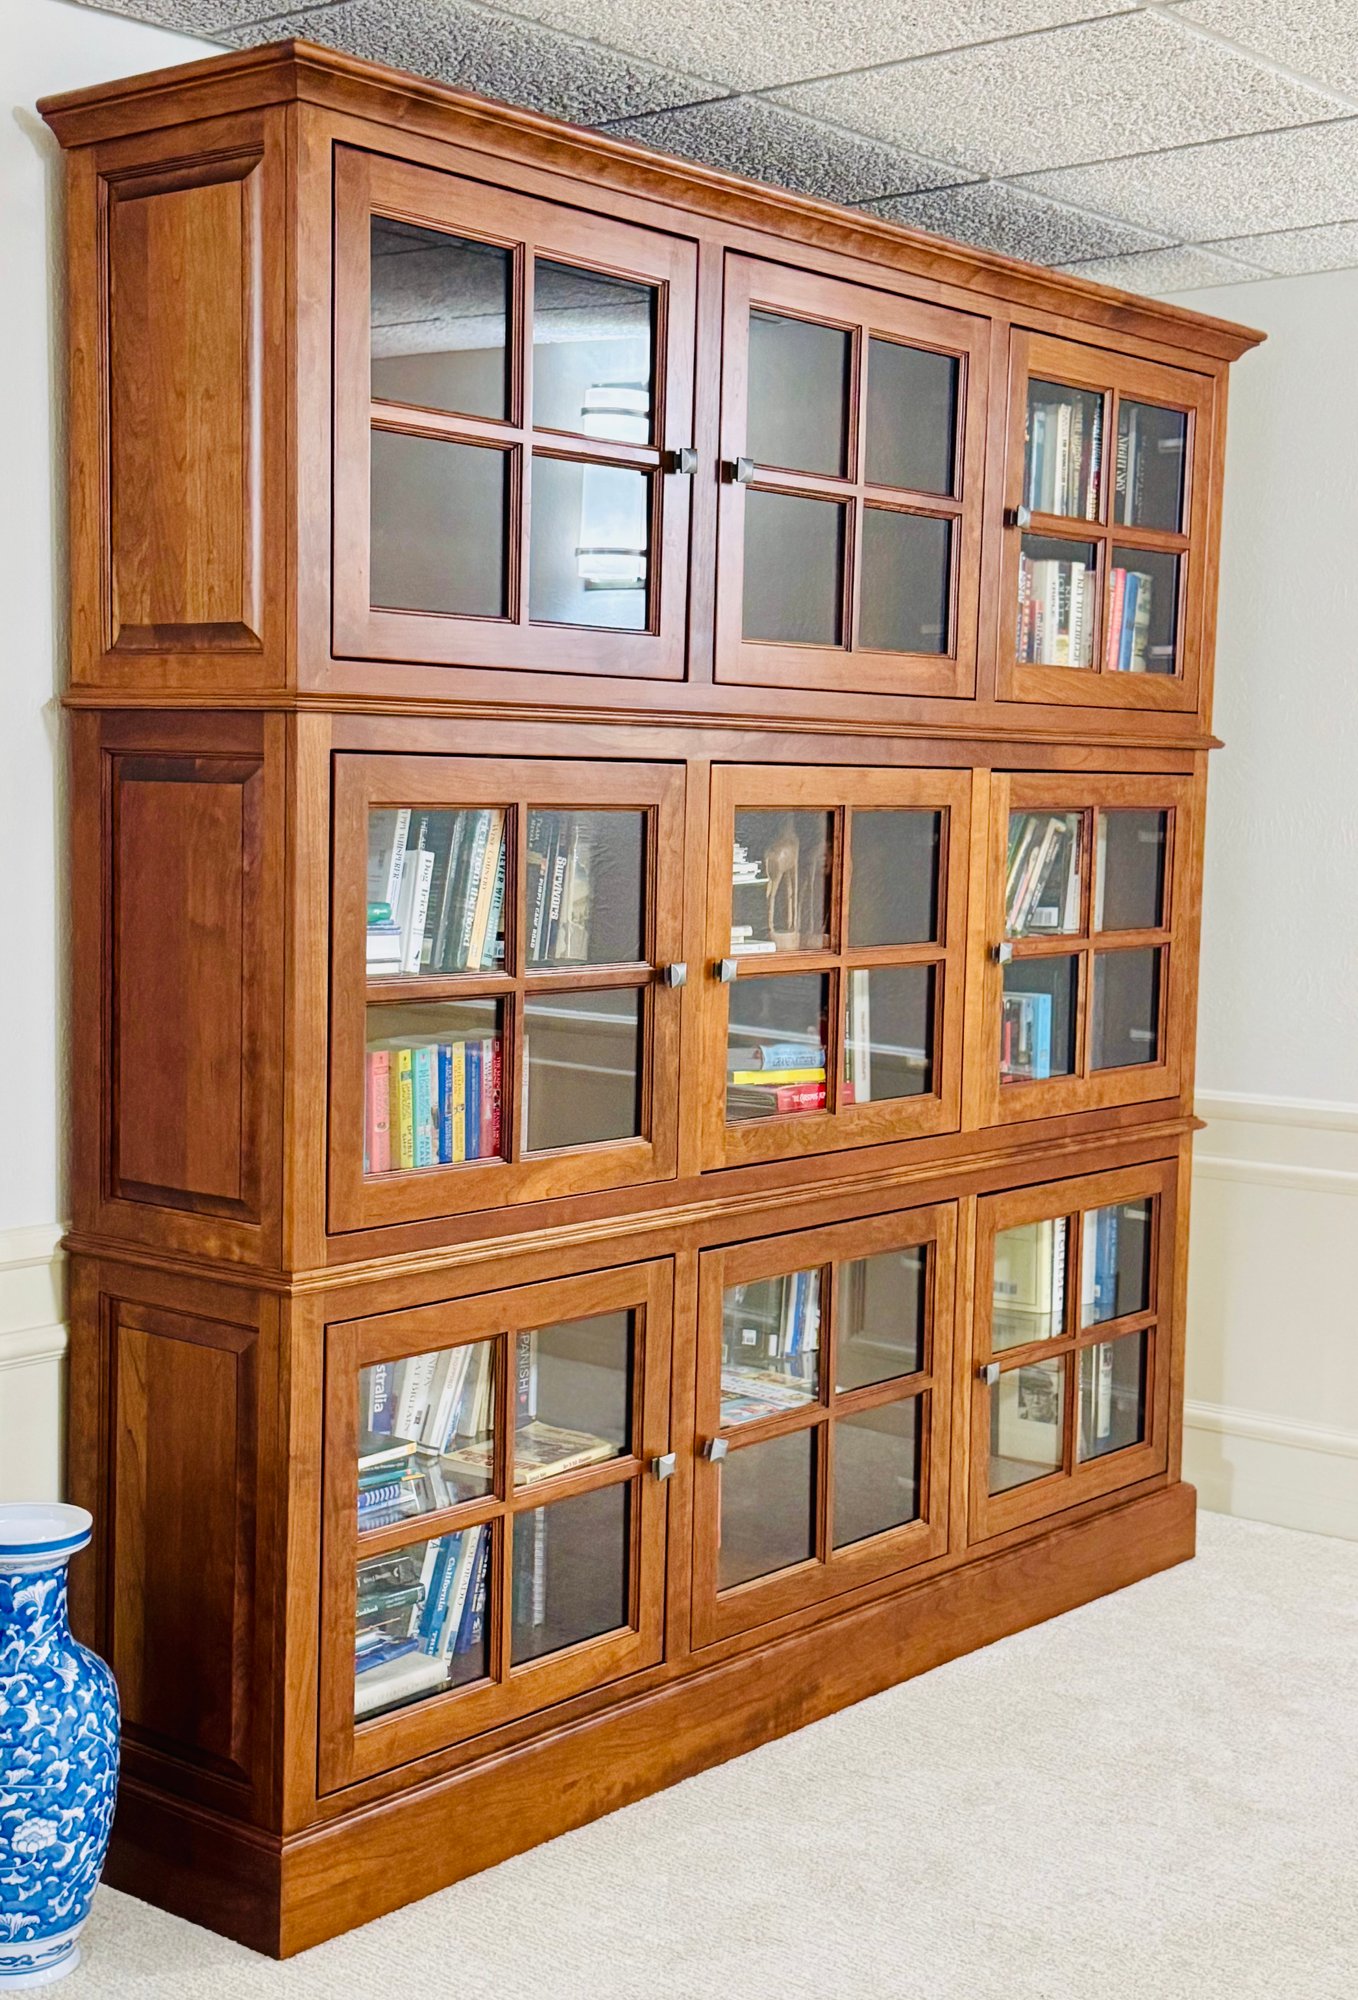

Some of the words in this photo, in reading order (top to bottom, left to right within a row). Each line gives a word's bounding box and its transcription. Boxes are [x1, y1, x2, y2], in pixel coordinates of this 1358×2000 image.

[422, 858, 432, 882] Dog
[473, 847, 485, 885] From
[417, 888, 428, 924] Tricks
[468, 887, 479, 909] the
[551, 856, 567, 921] Survivors
[463, 911, 476, 947] Road
[438, 1556, 456, 1612] California
